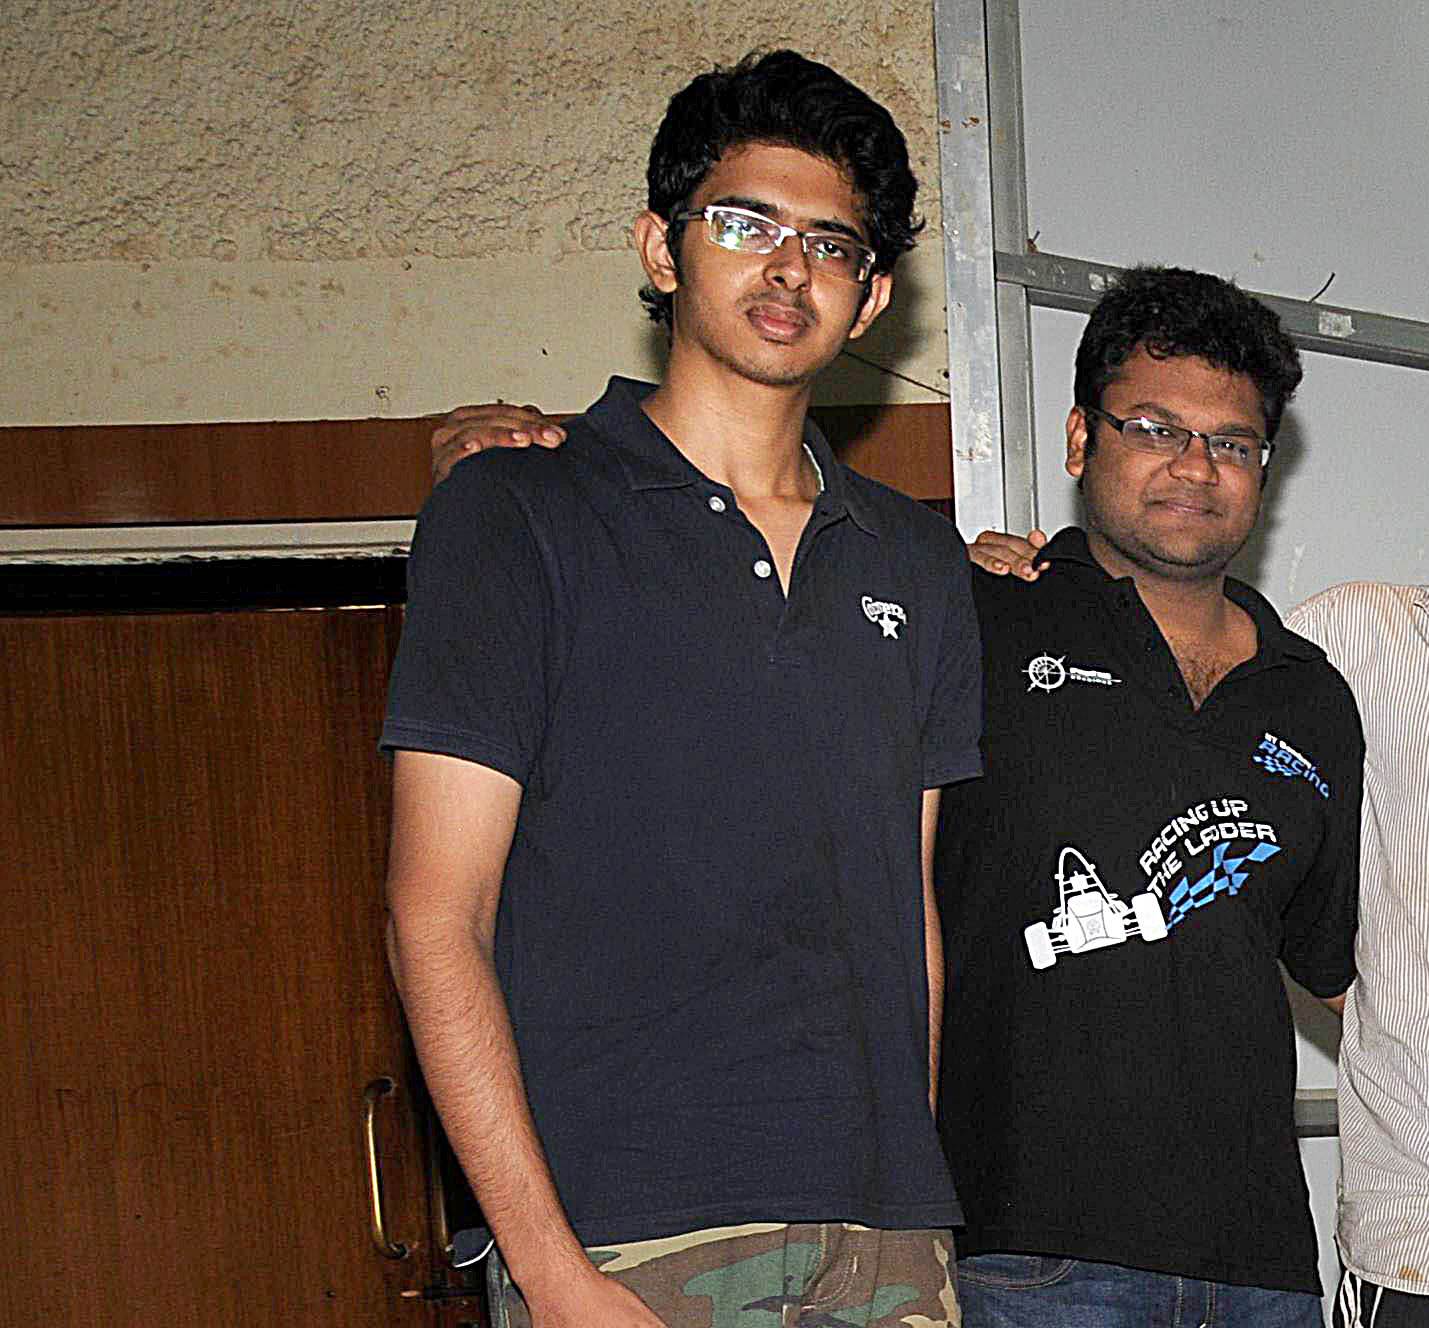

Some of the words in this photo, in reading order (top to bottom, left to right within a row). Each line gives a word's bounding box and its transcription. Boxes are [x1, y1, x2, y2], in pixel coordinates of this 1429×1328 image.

[1139, 804, 1209, 876] RACING
[1211, 799, 1248, 818] UP
[1147, 851, 1183, 898] THE
